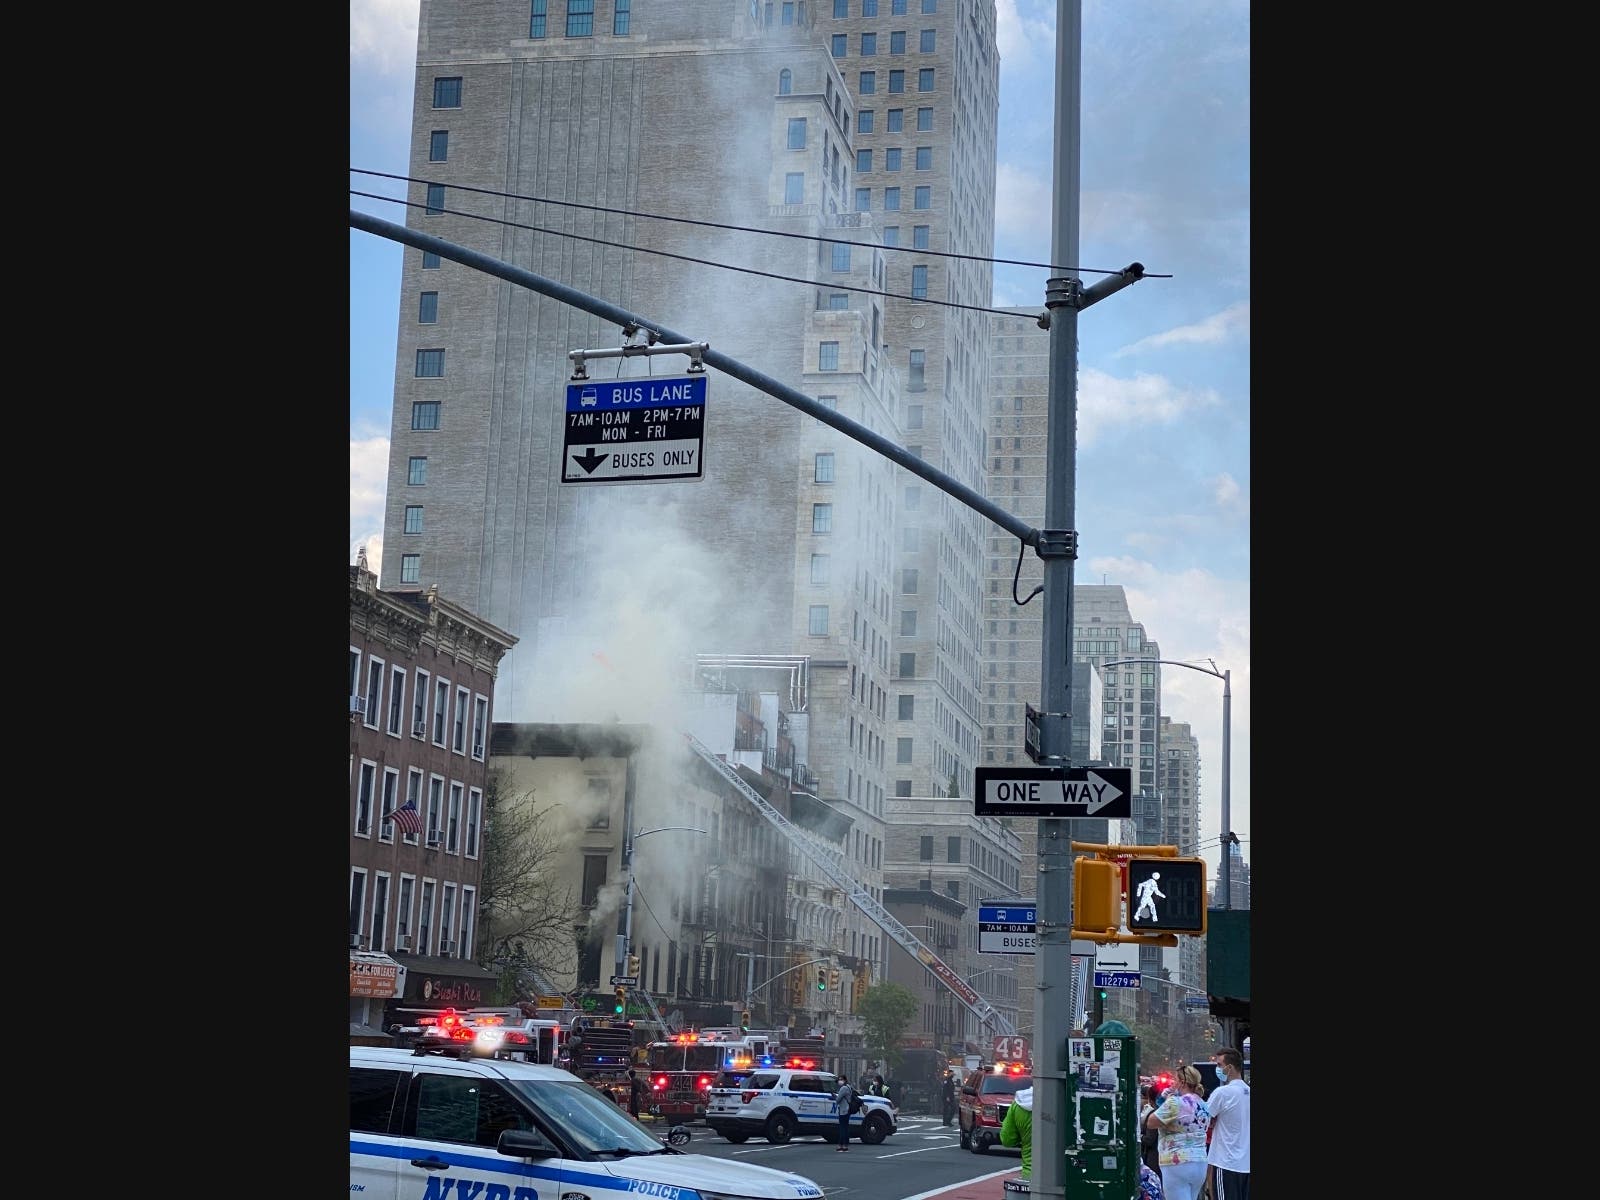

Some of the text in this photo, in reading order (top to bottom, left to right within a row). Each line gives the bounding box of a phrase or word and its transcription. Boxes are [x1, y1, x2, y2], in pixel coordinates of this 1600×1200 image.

[612, 384, 692, 404] BUS LANE
[602, 427, 627, 441] MON
[647, 425, 667, 439] FRI
[612, 450, 694, 468] BUSES ONLY
[997, 783, 1107, 803] ONE WAY
[380, 967, 396, 978] LEASE
[1101, 977, 1129, 986] 112279
[432, 979, 461, 1000] Sushi
[936, 966, 977, 1002] 43 TRUCK
[996, 1037, 1025, 1059] 43
[629, 1180, 679, 1200] POLICE
